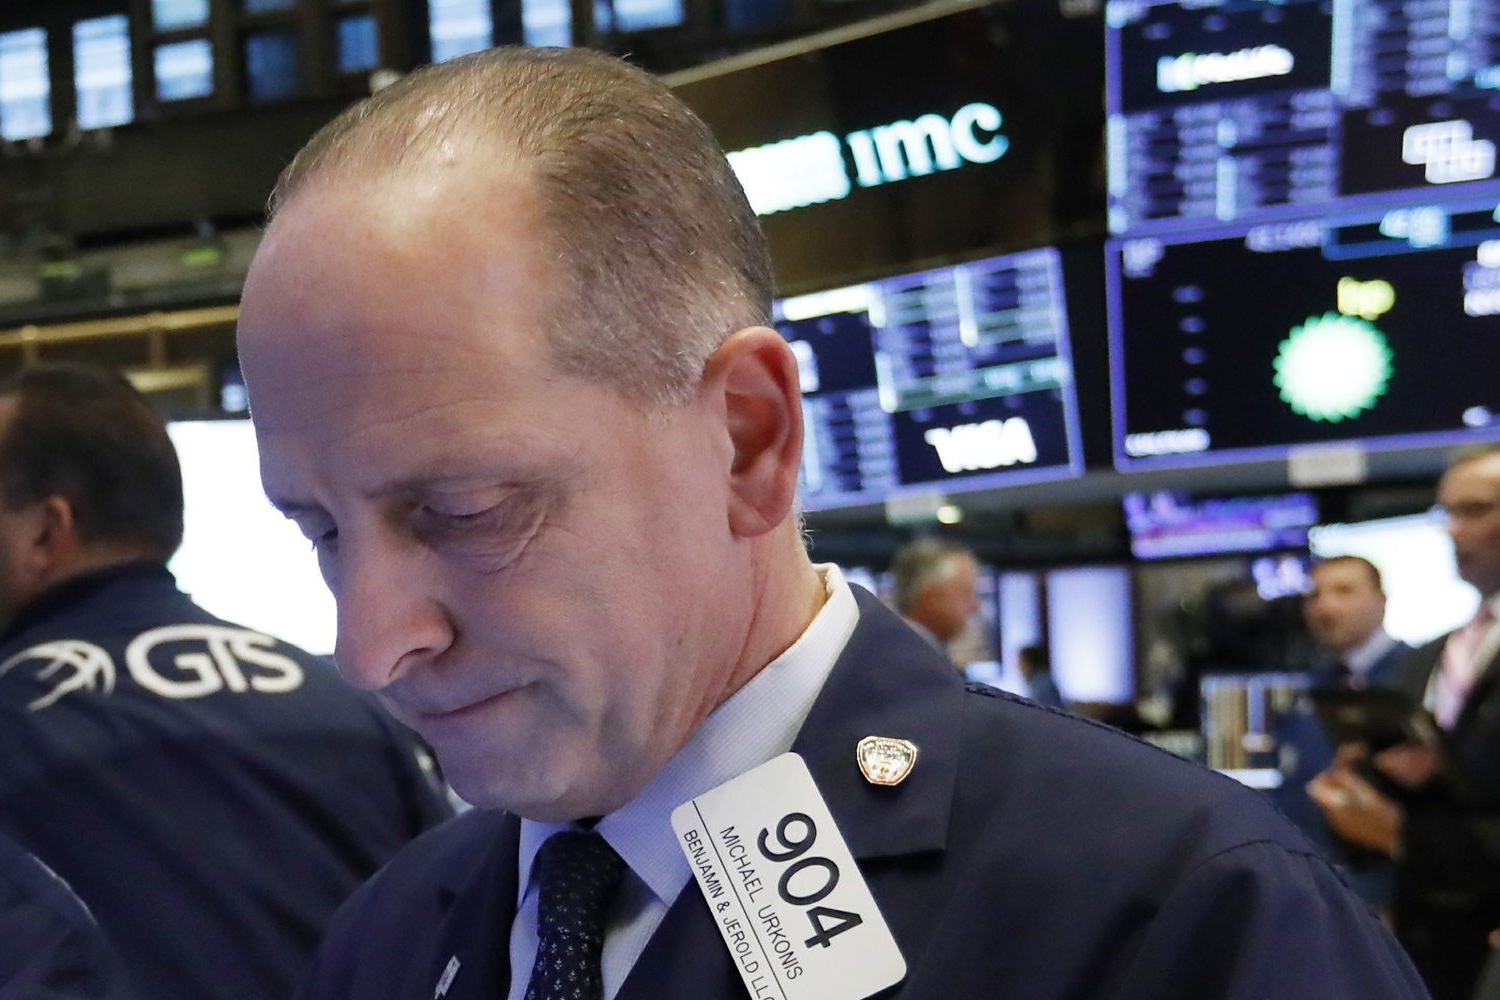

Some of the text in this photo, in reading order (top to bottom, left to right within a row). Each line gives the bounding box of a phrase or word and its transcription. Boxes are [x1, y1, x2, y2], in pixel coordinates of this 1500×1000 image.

[124, 623, 305, 700] GTS
[683, 829, 725, 899] BENJAMIN
[756, 812, 864, 949] 904
[716, 900, 730, 914] &
[719, 825, 804, 980] MICHAEL URKONIS
[722, 917, 759, 974] JEROLD
